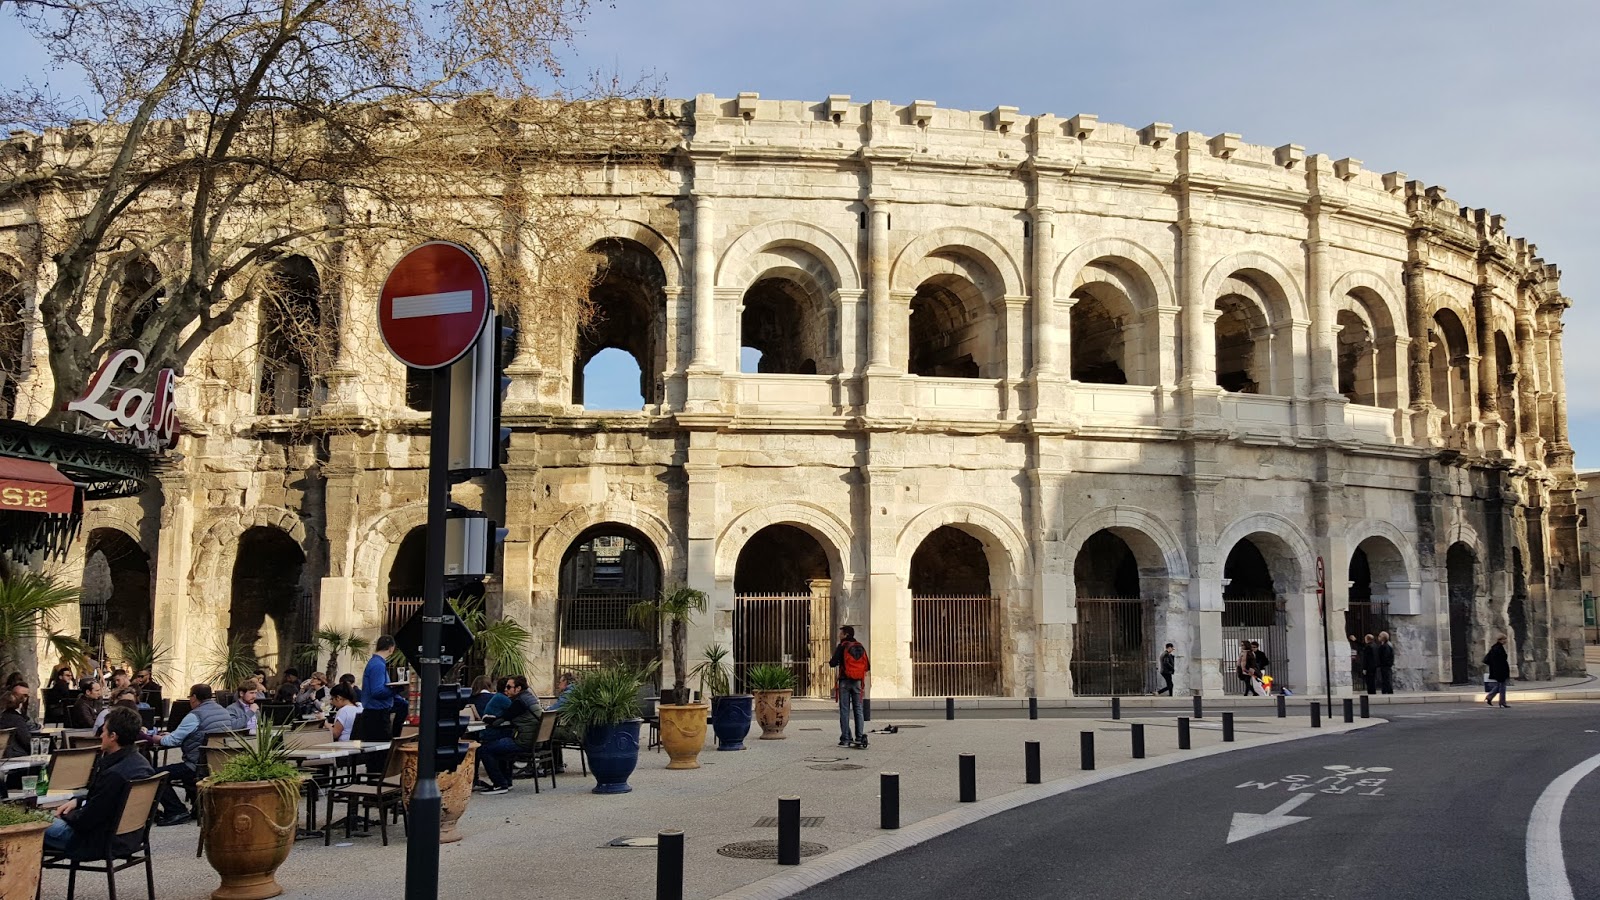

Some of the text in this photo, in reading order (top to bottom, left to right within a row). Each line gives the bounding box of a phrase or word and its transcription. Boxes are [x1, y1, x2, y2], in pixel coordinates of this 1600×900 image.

[1, 487, 47, 508] SE
[1235, 780, 1385, 796] TRAM
[1280, 774, 1387, 787] BUS
